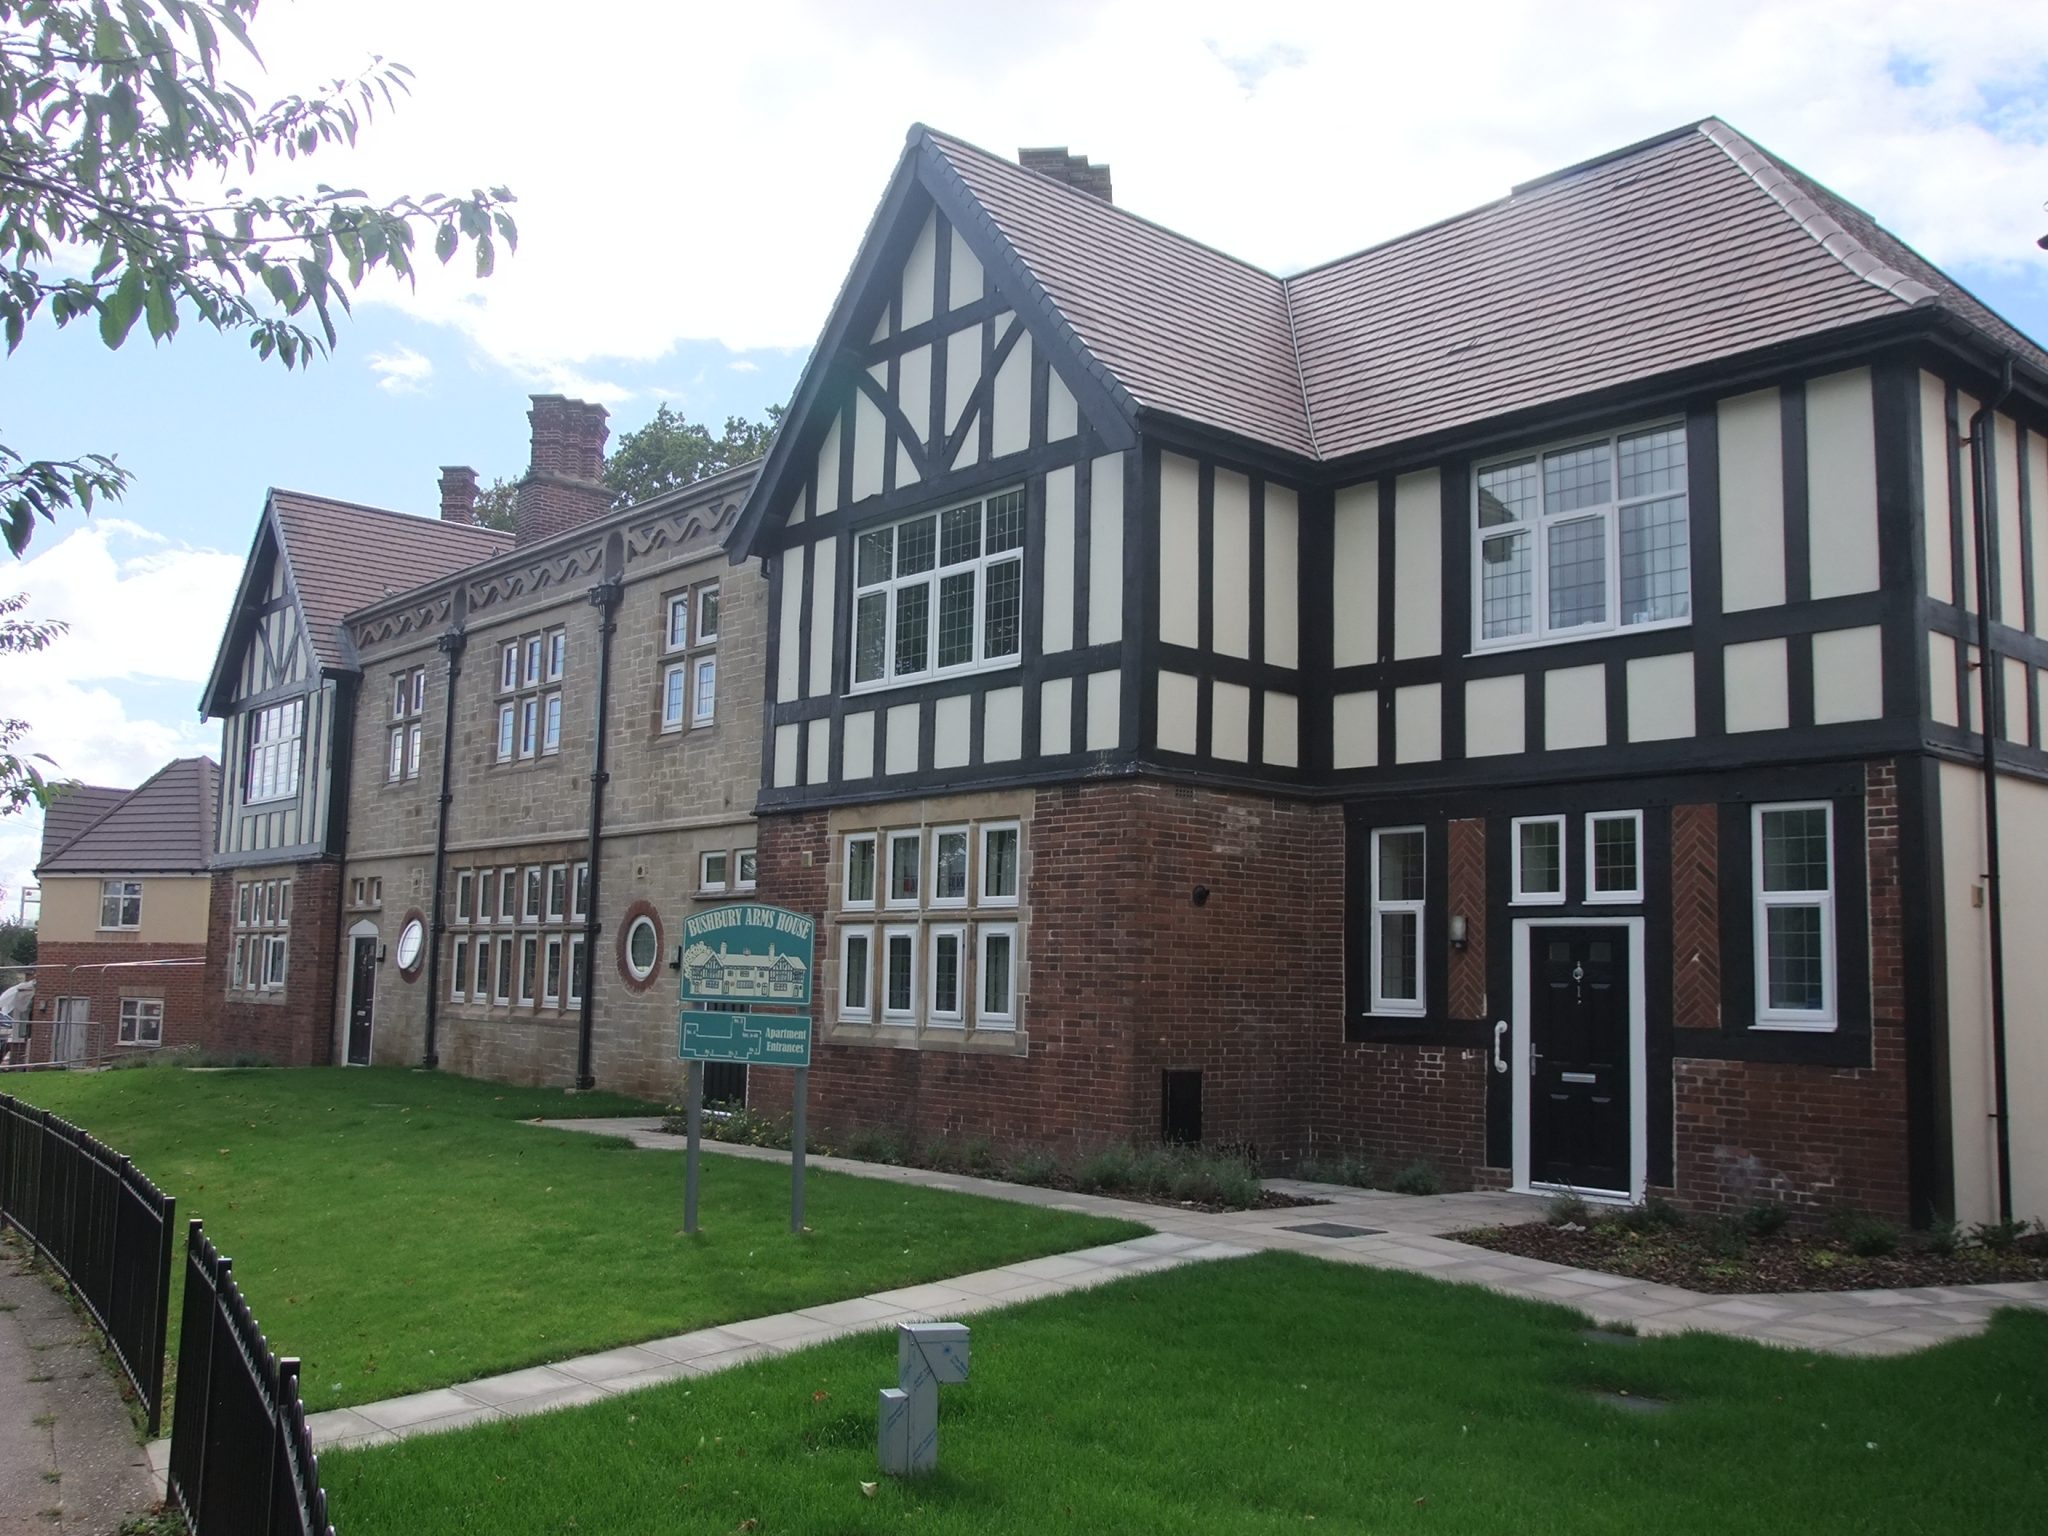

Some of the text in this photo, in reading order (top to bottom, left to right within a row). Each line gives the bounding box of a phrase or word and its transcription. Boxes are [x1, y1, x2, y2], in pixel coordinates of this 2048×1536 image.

[686, 908, 812, 940] BUSHBURY ARMS HOUSE
[765, 1027, 807, 1040] Apartment
[766, 1042, 804, 1054] Entrances
